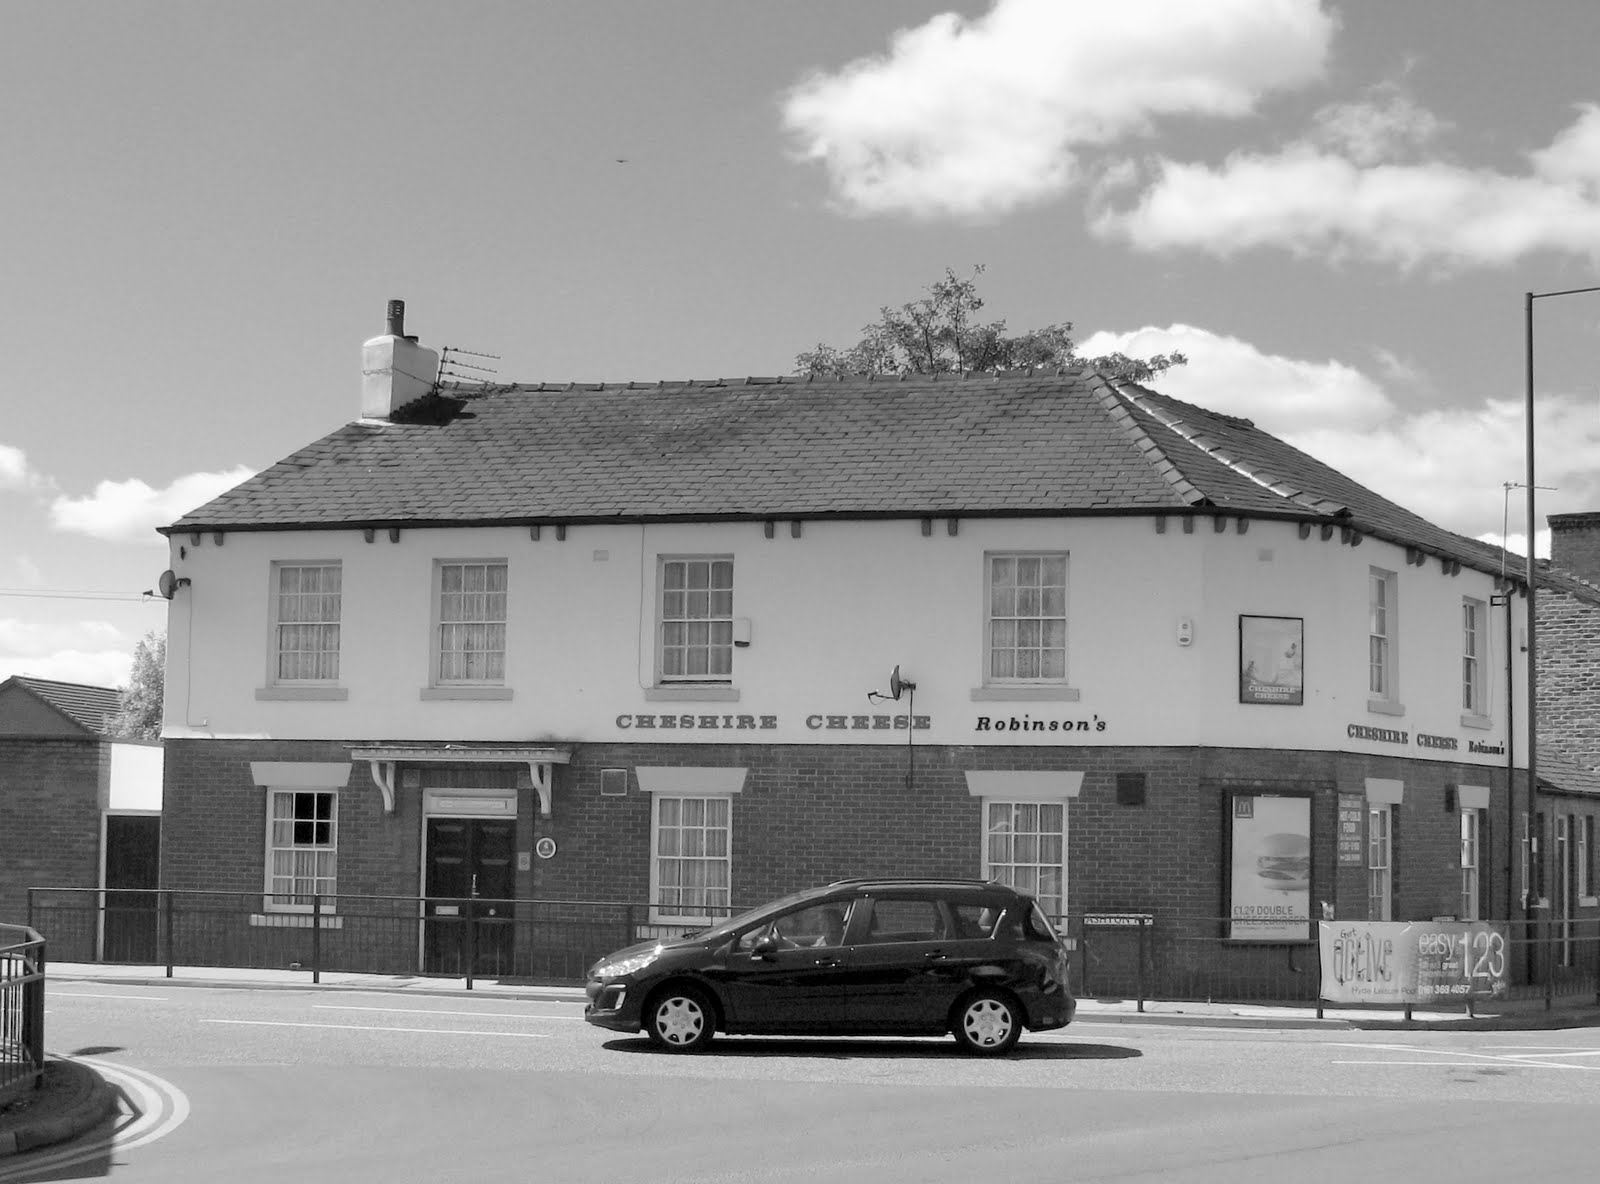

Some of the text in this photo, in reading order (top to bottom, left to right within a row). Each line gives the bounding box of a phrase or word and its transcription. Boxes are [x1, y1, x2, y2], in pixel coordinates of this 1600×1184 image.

[616, 715, 931, 730] CHESHIRE CHEESE
[976, 714, 1107, 732] Robinson's
[1347, 724, 1458, 751] CHESHIRE CHEESE
[1468, 740, 1505, 756] Robinson's
[1257, 906, 1293, 916] DOUBLE
[1341, 927, 1357, 939] Get
[1419, 931, 1504, 978] easy 123
[1451, 984, 1471, 994] 4057
